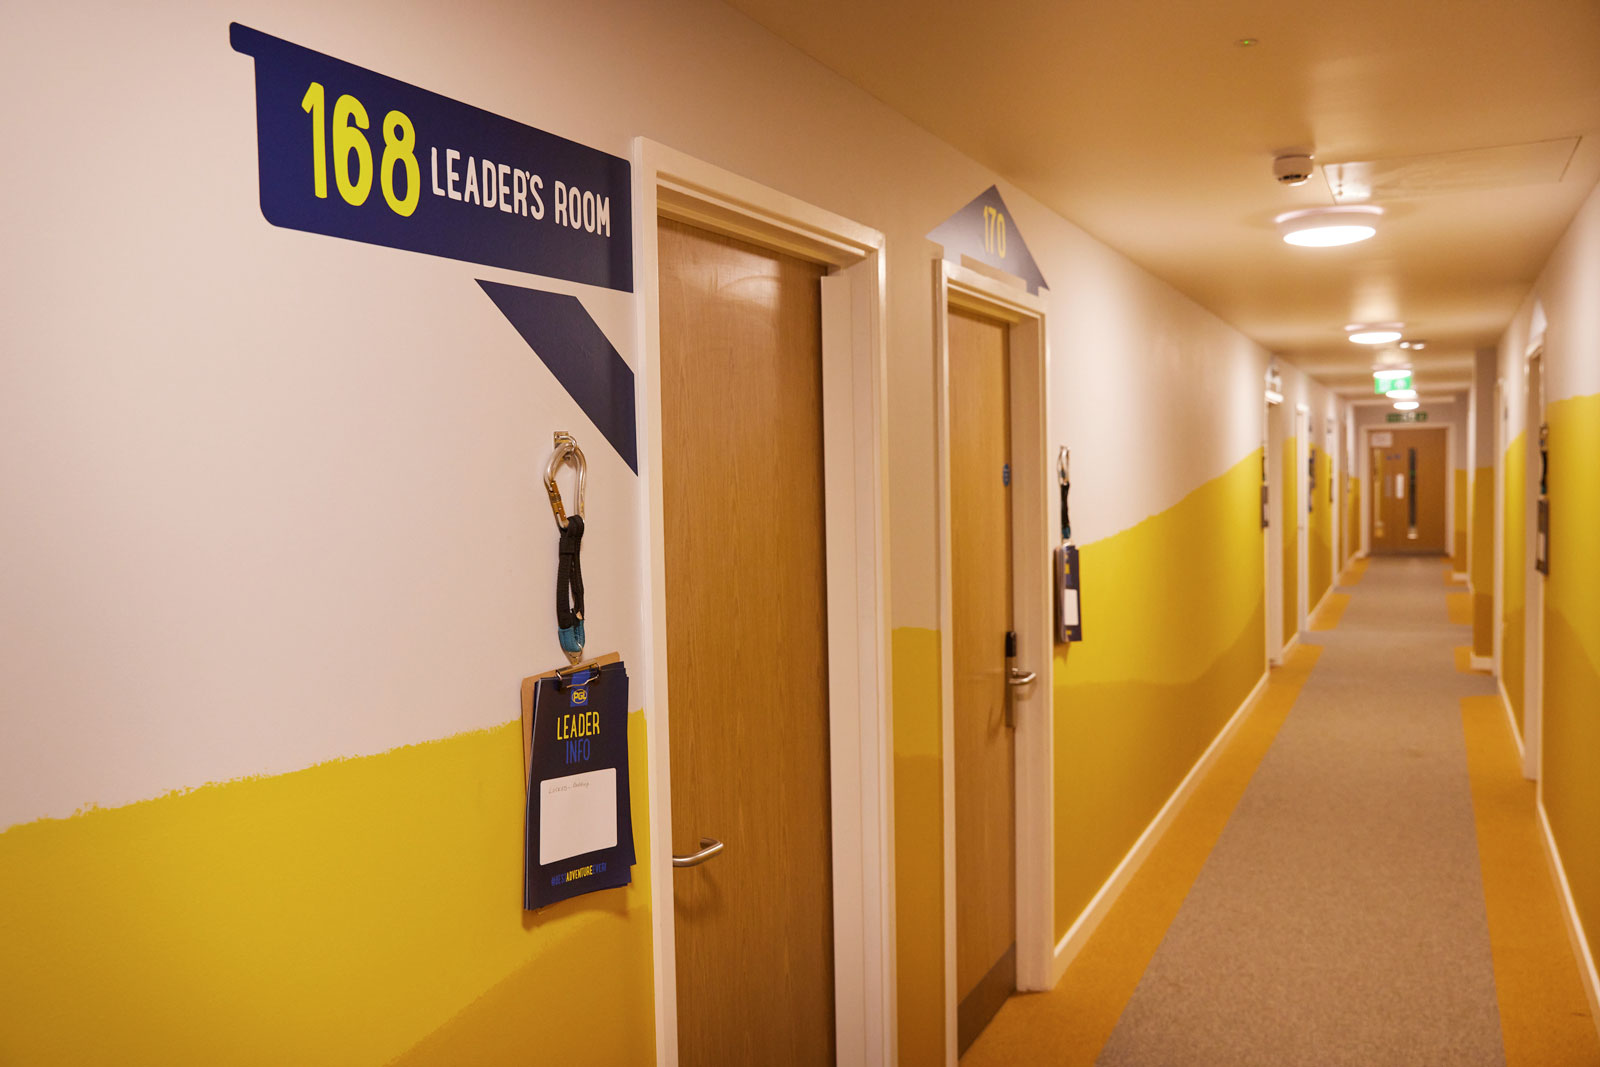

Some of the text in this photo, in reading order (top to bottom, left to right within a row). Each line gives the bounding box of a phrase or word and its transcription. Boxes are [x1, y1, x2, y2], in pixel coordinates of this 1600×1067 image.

[301, 82, 611, 238] 168 LEADER'S ROOM
[983, 205, 1006, 258] 170
[557, 711, 600, 740] LEADER
[566, 738, 591, 764] INFO
